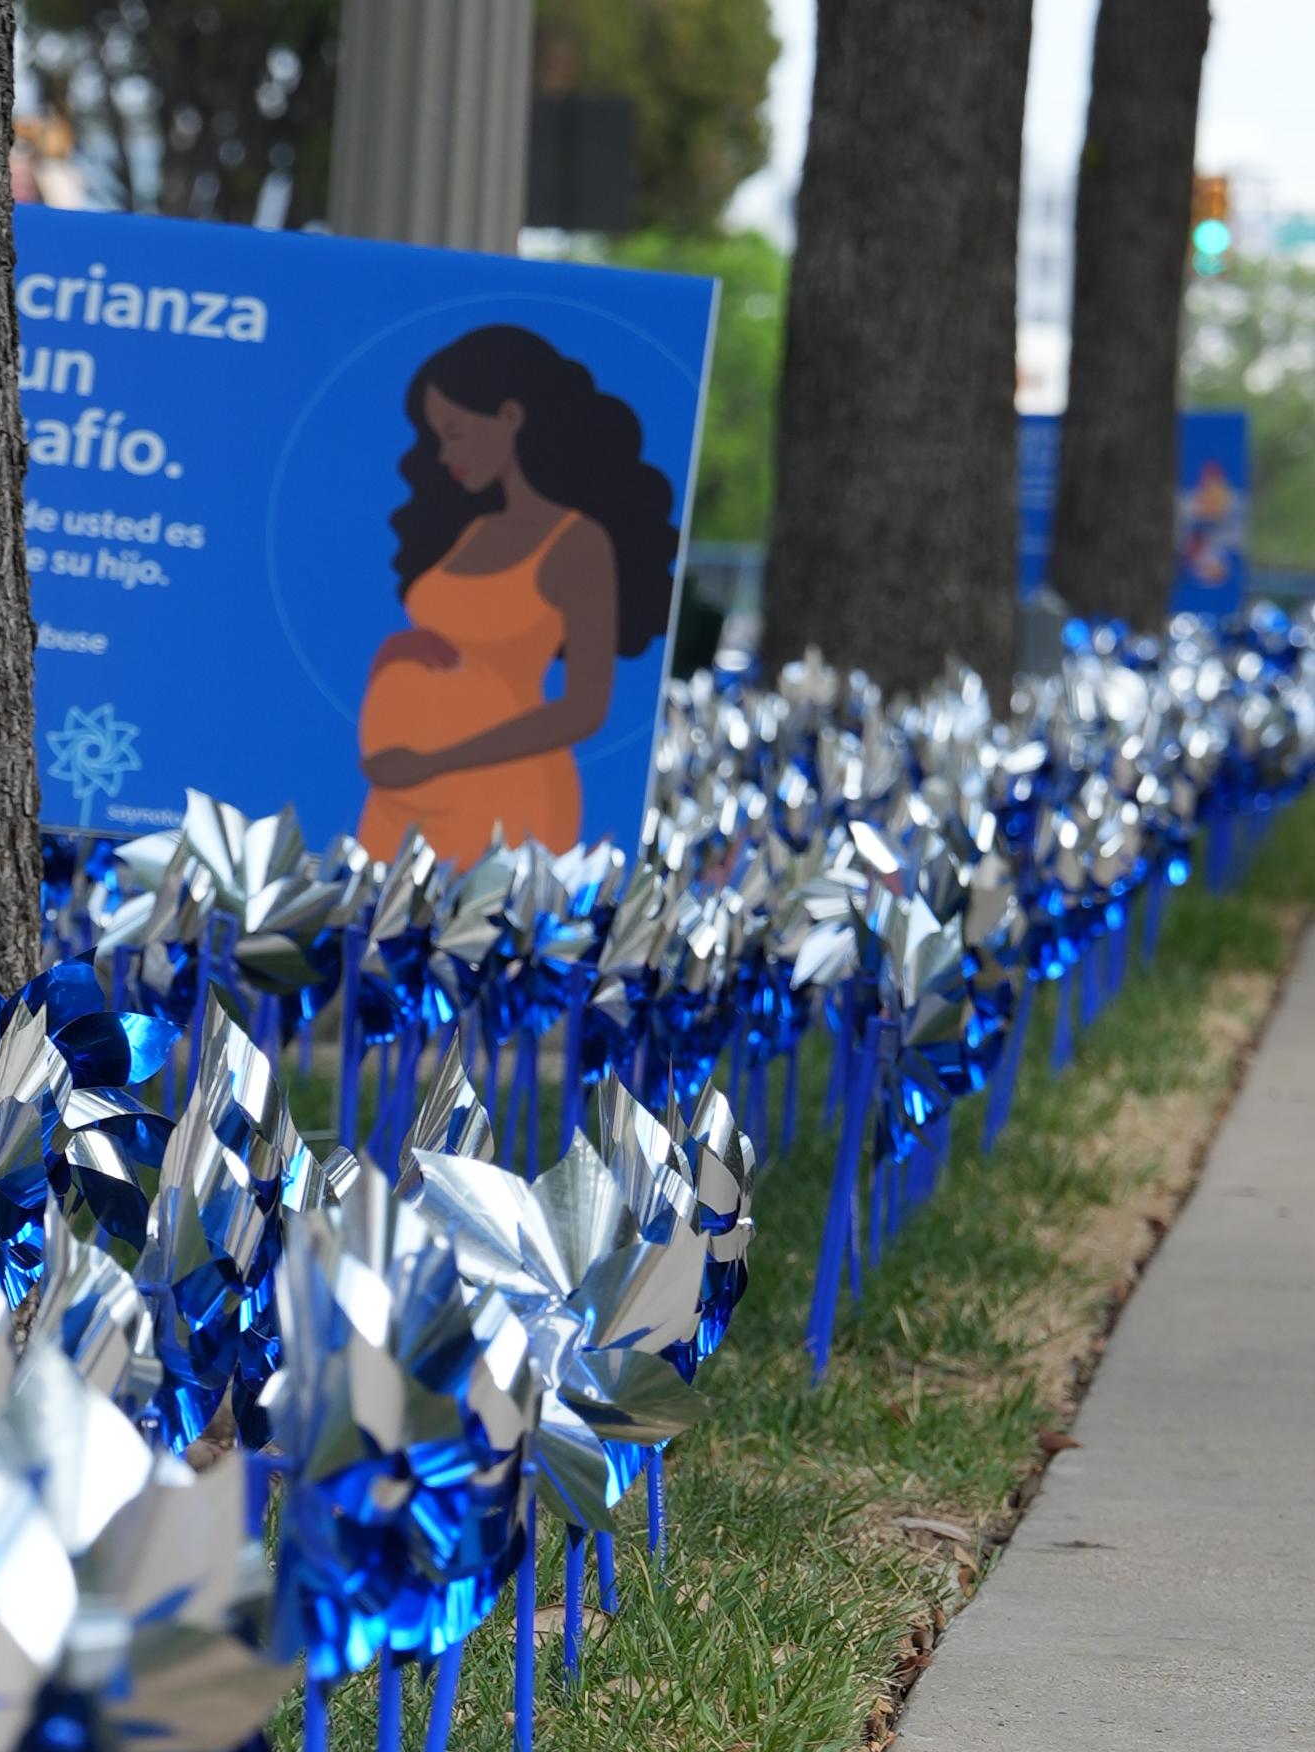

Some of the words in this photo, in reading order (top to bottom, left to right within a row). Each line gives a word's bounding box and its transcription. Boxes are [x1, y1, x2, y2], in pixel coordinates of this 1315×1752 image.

[16, 262, 268, 343] crianza
[18, 344, 96, 397] un
[22, 406, 184, 480] afío.
[63, 509, 162, 545] usted
[164, 521, 206, 550] es
[49, 549, 92, 578] su
[95, 546, 170, 591] hijo.
